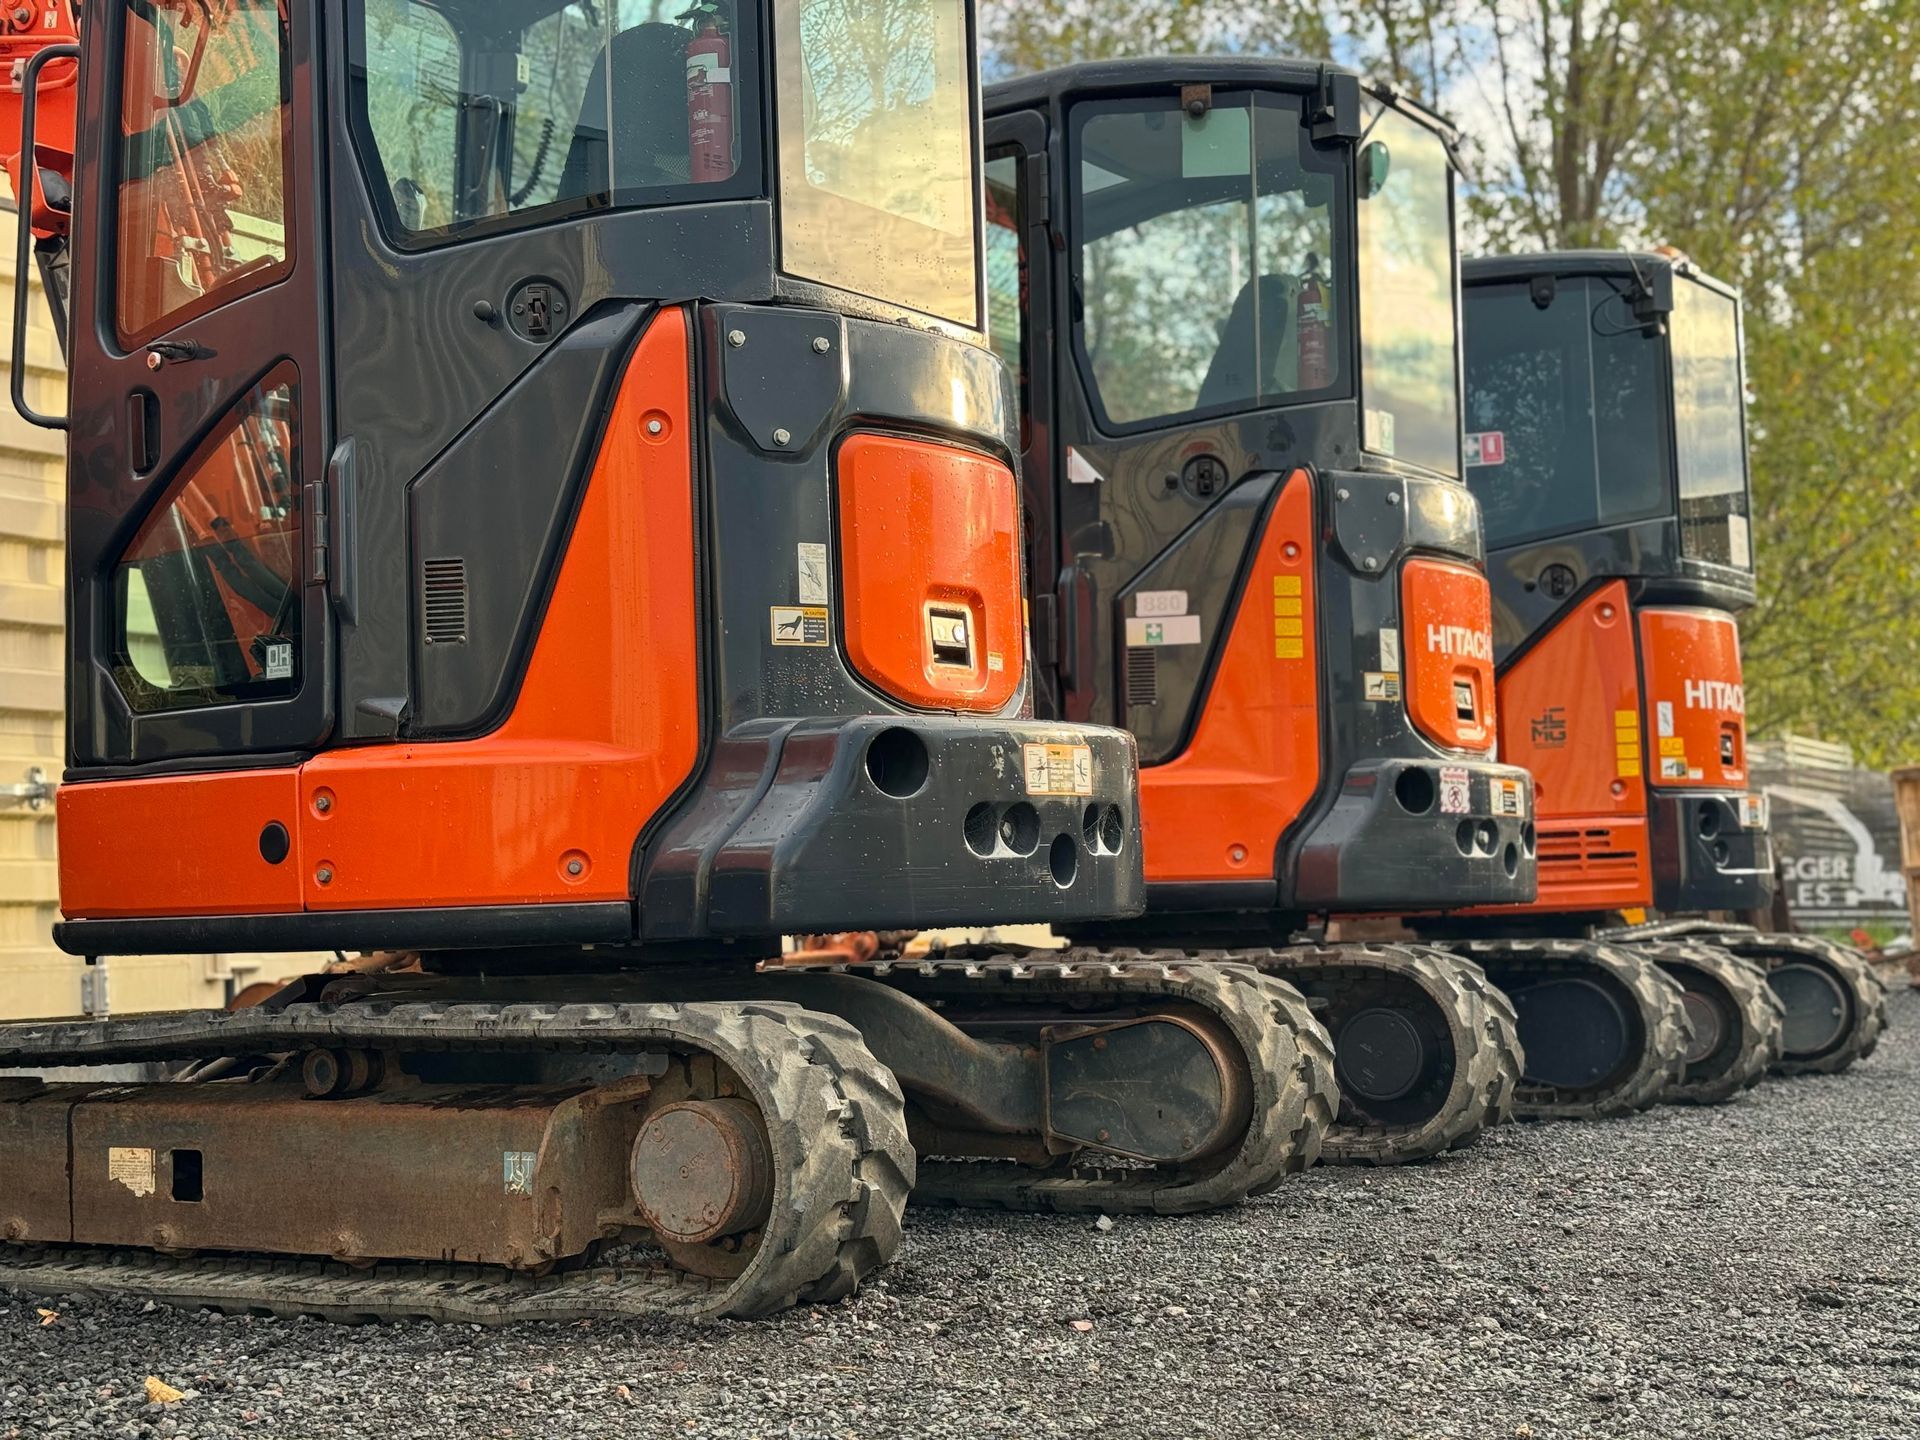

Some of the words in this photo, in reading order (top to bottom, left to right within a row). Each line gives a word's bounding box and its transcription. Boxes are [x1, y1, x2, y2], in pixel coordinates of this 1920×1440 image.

[1143, 594, 1181, 612] 880
[1427, 623, 1494, 662] HITACH
[1685, 679, 1744, 714] HITAC
[1781, 856, 1850, 881] GGER
[1787, 882, 1832, 907] ES
